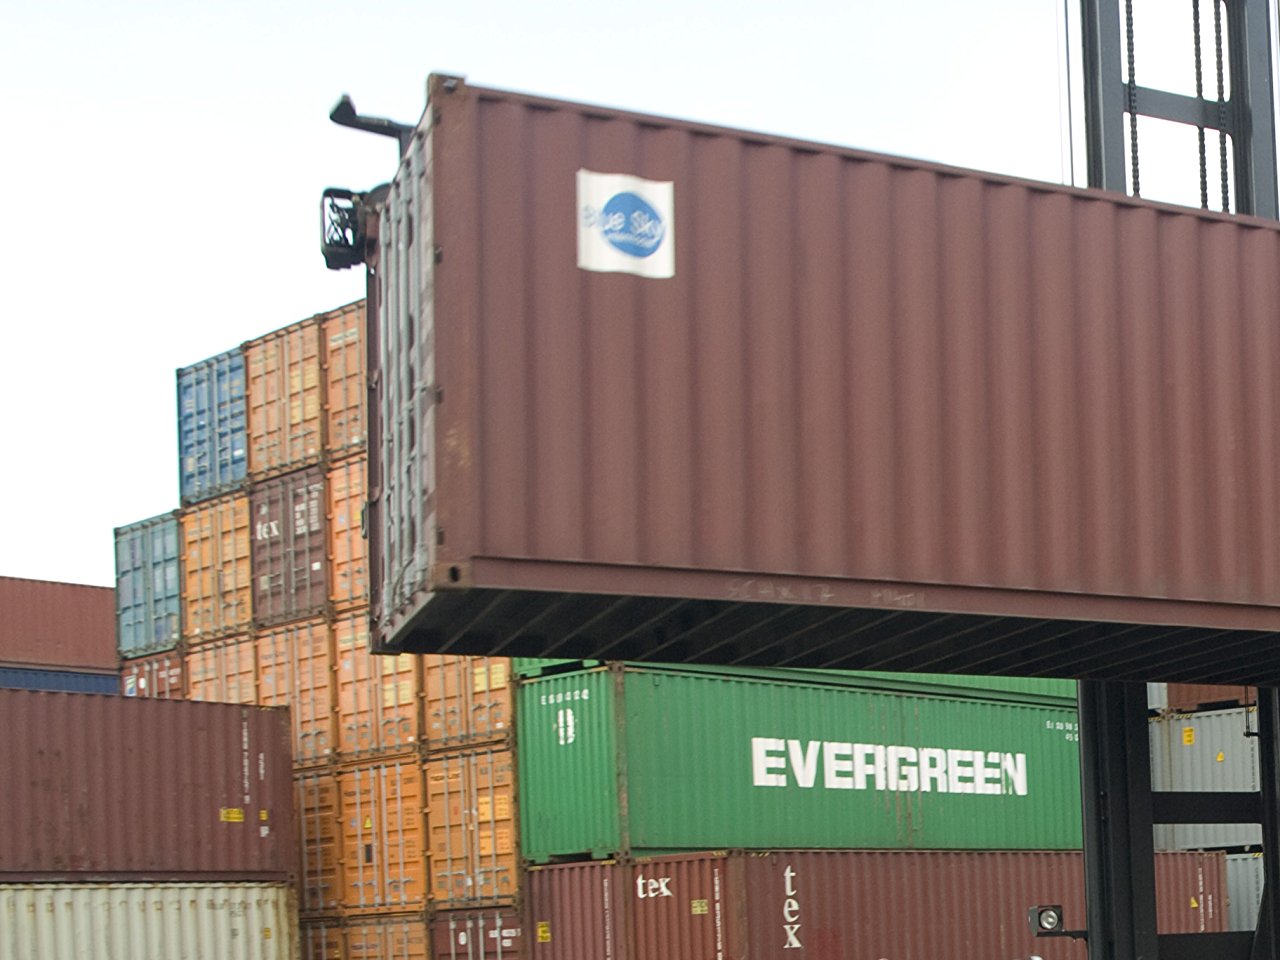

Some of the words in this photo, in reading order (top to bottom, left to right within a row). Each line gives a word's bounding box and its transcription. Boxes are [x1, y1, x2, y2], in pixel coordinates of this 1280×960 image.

[256, 519, 280, 541] tex
[752, 737, 1028, 796] EVERGREEN
[637, 874, 674, 898] tex
[783, 865, 802, 948] tex
